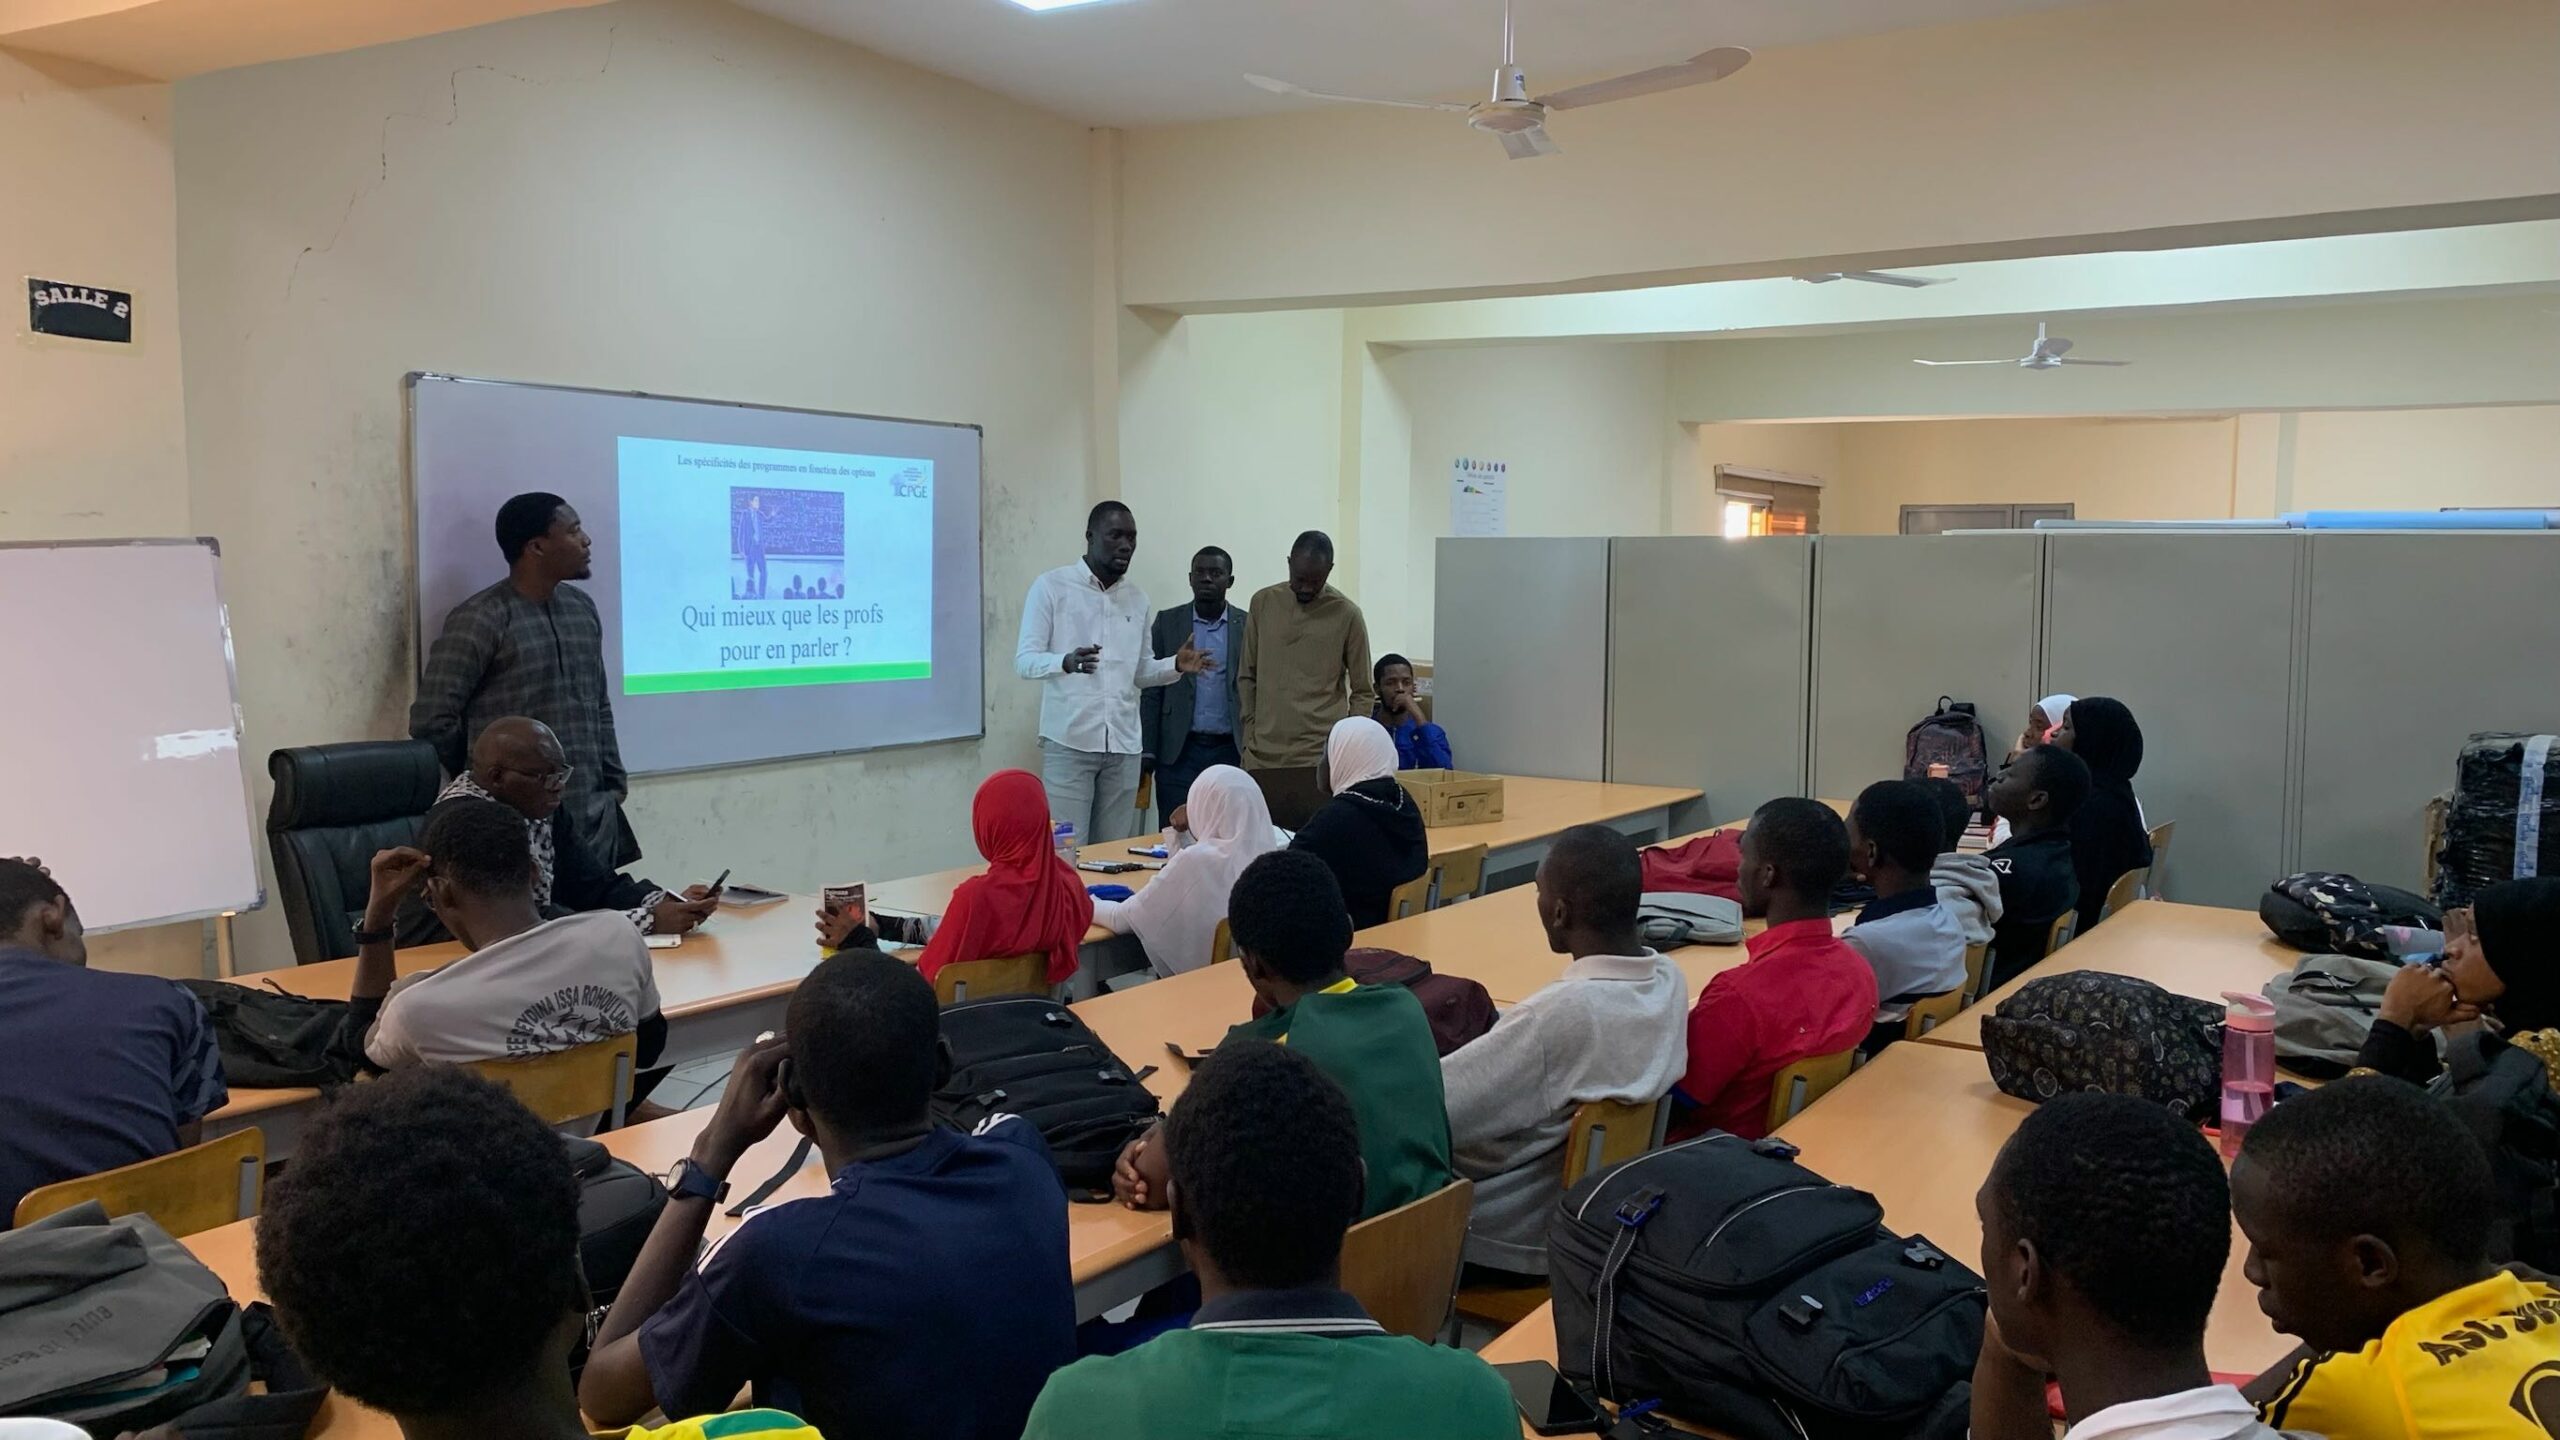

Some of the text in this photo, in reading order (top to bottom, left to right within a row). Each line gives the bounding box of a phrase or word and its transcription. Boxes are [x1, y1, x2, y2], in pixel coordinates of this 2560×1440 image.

[34, 287, 130, 319] SALLE 2
[677, 454, 876, 479] Les spécificités des programmes en fonction des options
[681, 602, 884, 632] Qui mieux que les profs
[720, 636, 852, 667] pour en parler ?
[511, 995, 556, 1037] SEYDINA
[553, 985, 580, 1011] ISSA
